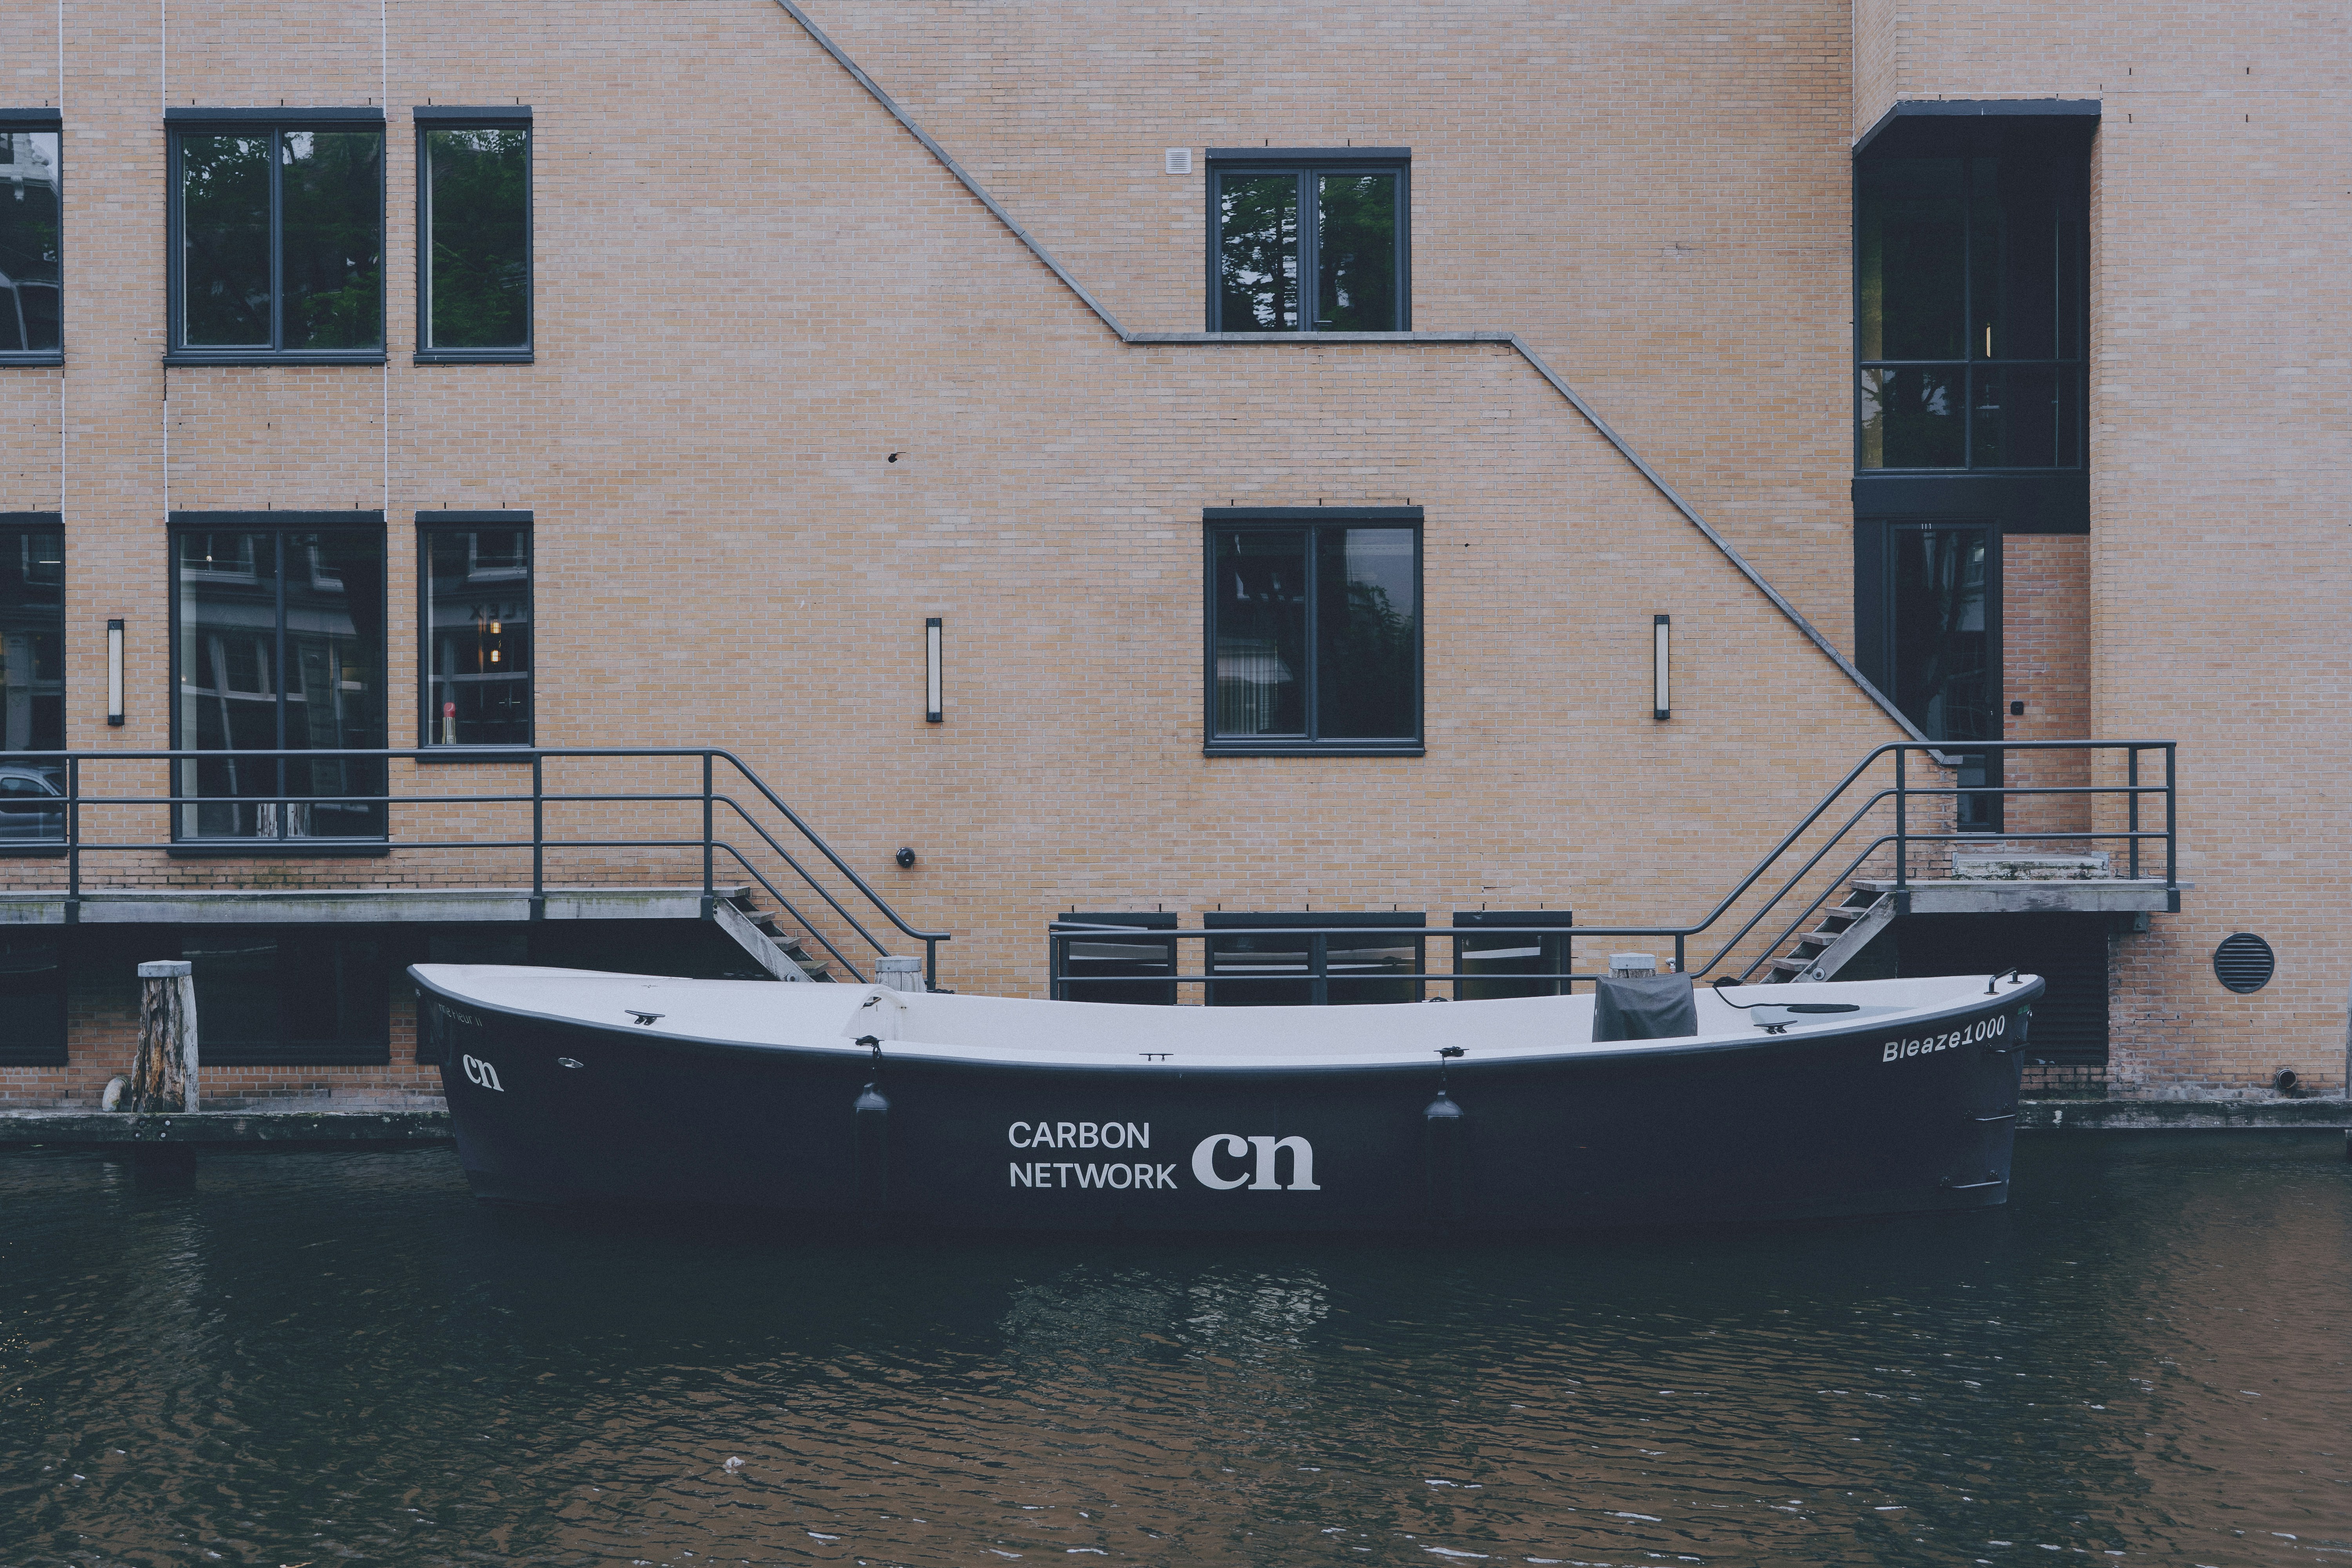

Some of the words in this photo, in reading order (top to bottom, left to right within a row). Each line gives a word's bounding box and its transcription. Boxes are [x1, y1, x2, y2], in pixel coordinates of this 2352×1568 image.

[1882, 1015, 2005, 1062] Bleaze1000
[463, 1054, 504, 1092] cn
[1008, 1121, 1149, 1149] CARBON
[1010, 1162, 1178, 1189] NETWORK
[1192, 1133, 1321, 1190] cn
